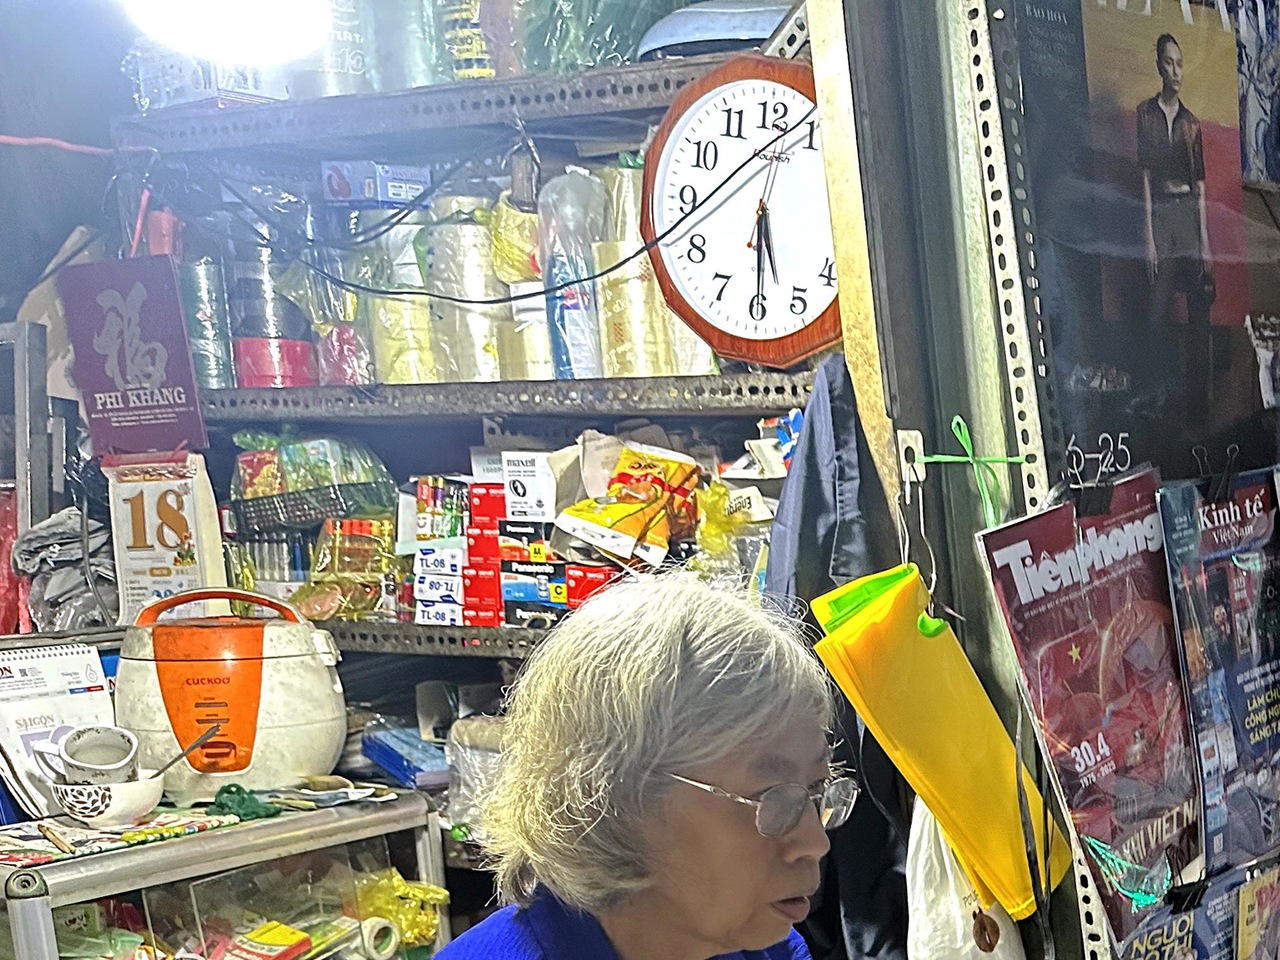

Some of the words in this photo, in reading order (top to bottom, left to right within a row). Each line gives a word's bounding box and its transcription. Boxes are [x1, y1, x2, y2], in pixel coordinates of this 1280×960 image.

[720, 109, 747, 139] 11
[756, 102, 789, 132] 12
[802, 121, 819, 150] 1
[692, 141, 718, 170] 10
[679, 185, 697, 214] 9
[687, 234, 706, 263] 8
[819, 257, 837, 287] 4
[713, 273, 732, 301] 7
[750, 294, 766, 320] 6
[790, 286, 807, 315] 5
[94, 391, 125, 410] PHI
[128, 386, 186, 406] KHANG
[507, 458, 536, 467] maxell
[122, 489, 192, 550] 18
[1199, 501, 1241, 530] Kinh
[1244, 488, 1265, 516] tế
[1232, 524, 1254, 537] Nam
[420, 558, 446, 568] TL-08
[511, 562, 555, 574] Panasonic
[428, 581, 454, 592] TL-08
[555, 586, 563, 595] C
[421, 610, 446, 621] TL-08
[85, 663, 98, 683] 6
[1245, 710, 1266, 730] CÔNG
[1250, 726, 1272, 745] SÁNG
[1071, 732, 1110, 773] 30.4
[1079, 774, 1096, 788] 1975
